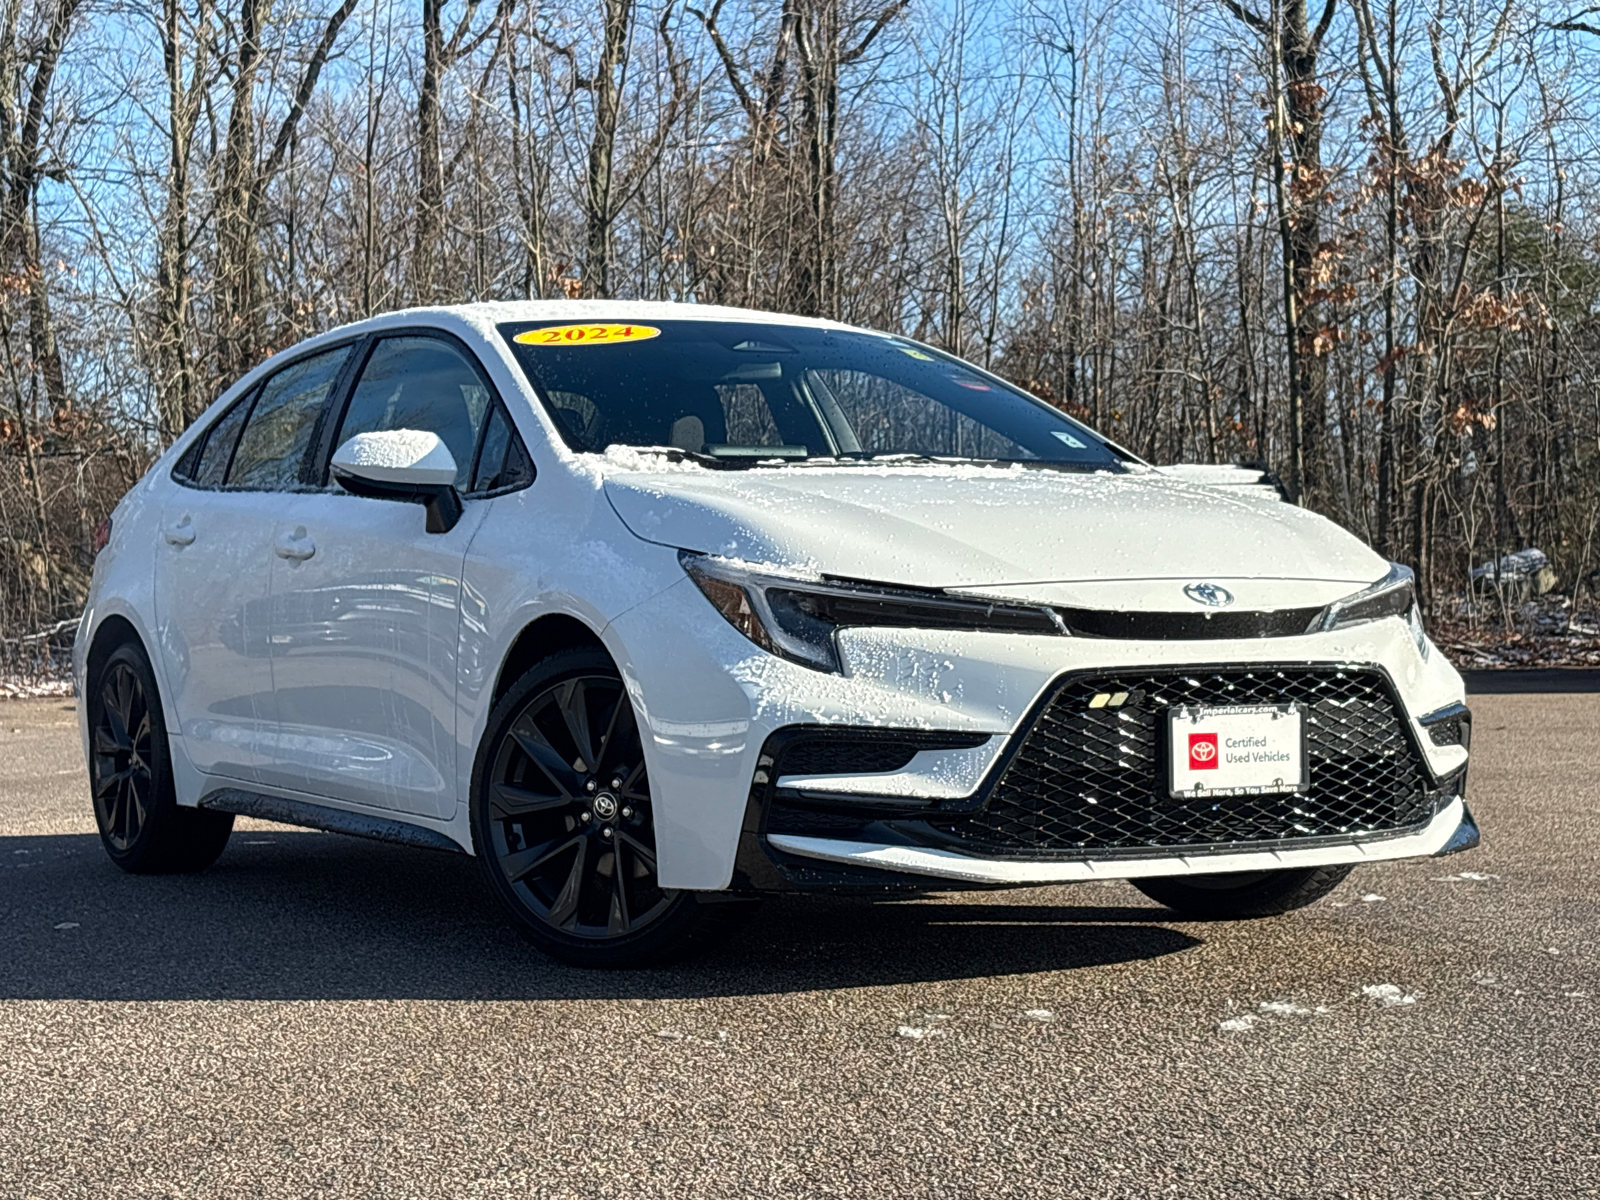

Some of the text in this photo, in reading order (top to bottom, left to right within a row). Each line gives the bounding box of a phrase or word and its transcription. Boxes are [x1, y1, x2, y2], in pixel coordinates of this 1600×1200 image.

[542, 327, 634, 343] 2024
[1225, 736, 1266, 748] Certified
[1226, 751, 1290, 763] Used Vehicles
[1184, 790, 1196, 798] We
[1197, 789, 1211, 797] Sell
[1235, 787, 1244, 795] So
[1246, 786, 1259, 794] You
[1261, 785, 1278, 793] Save
